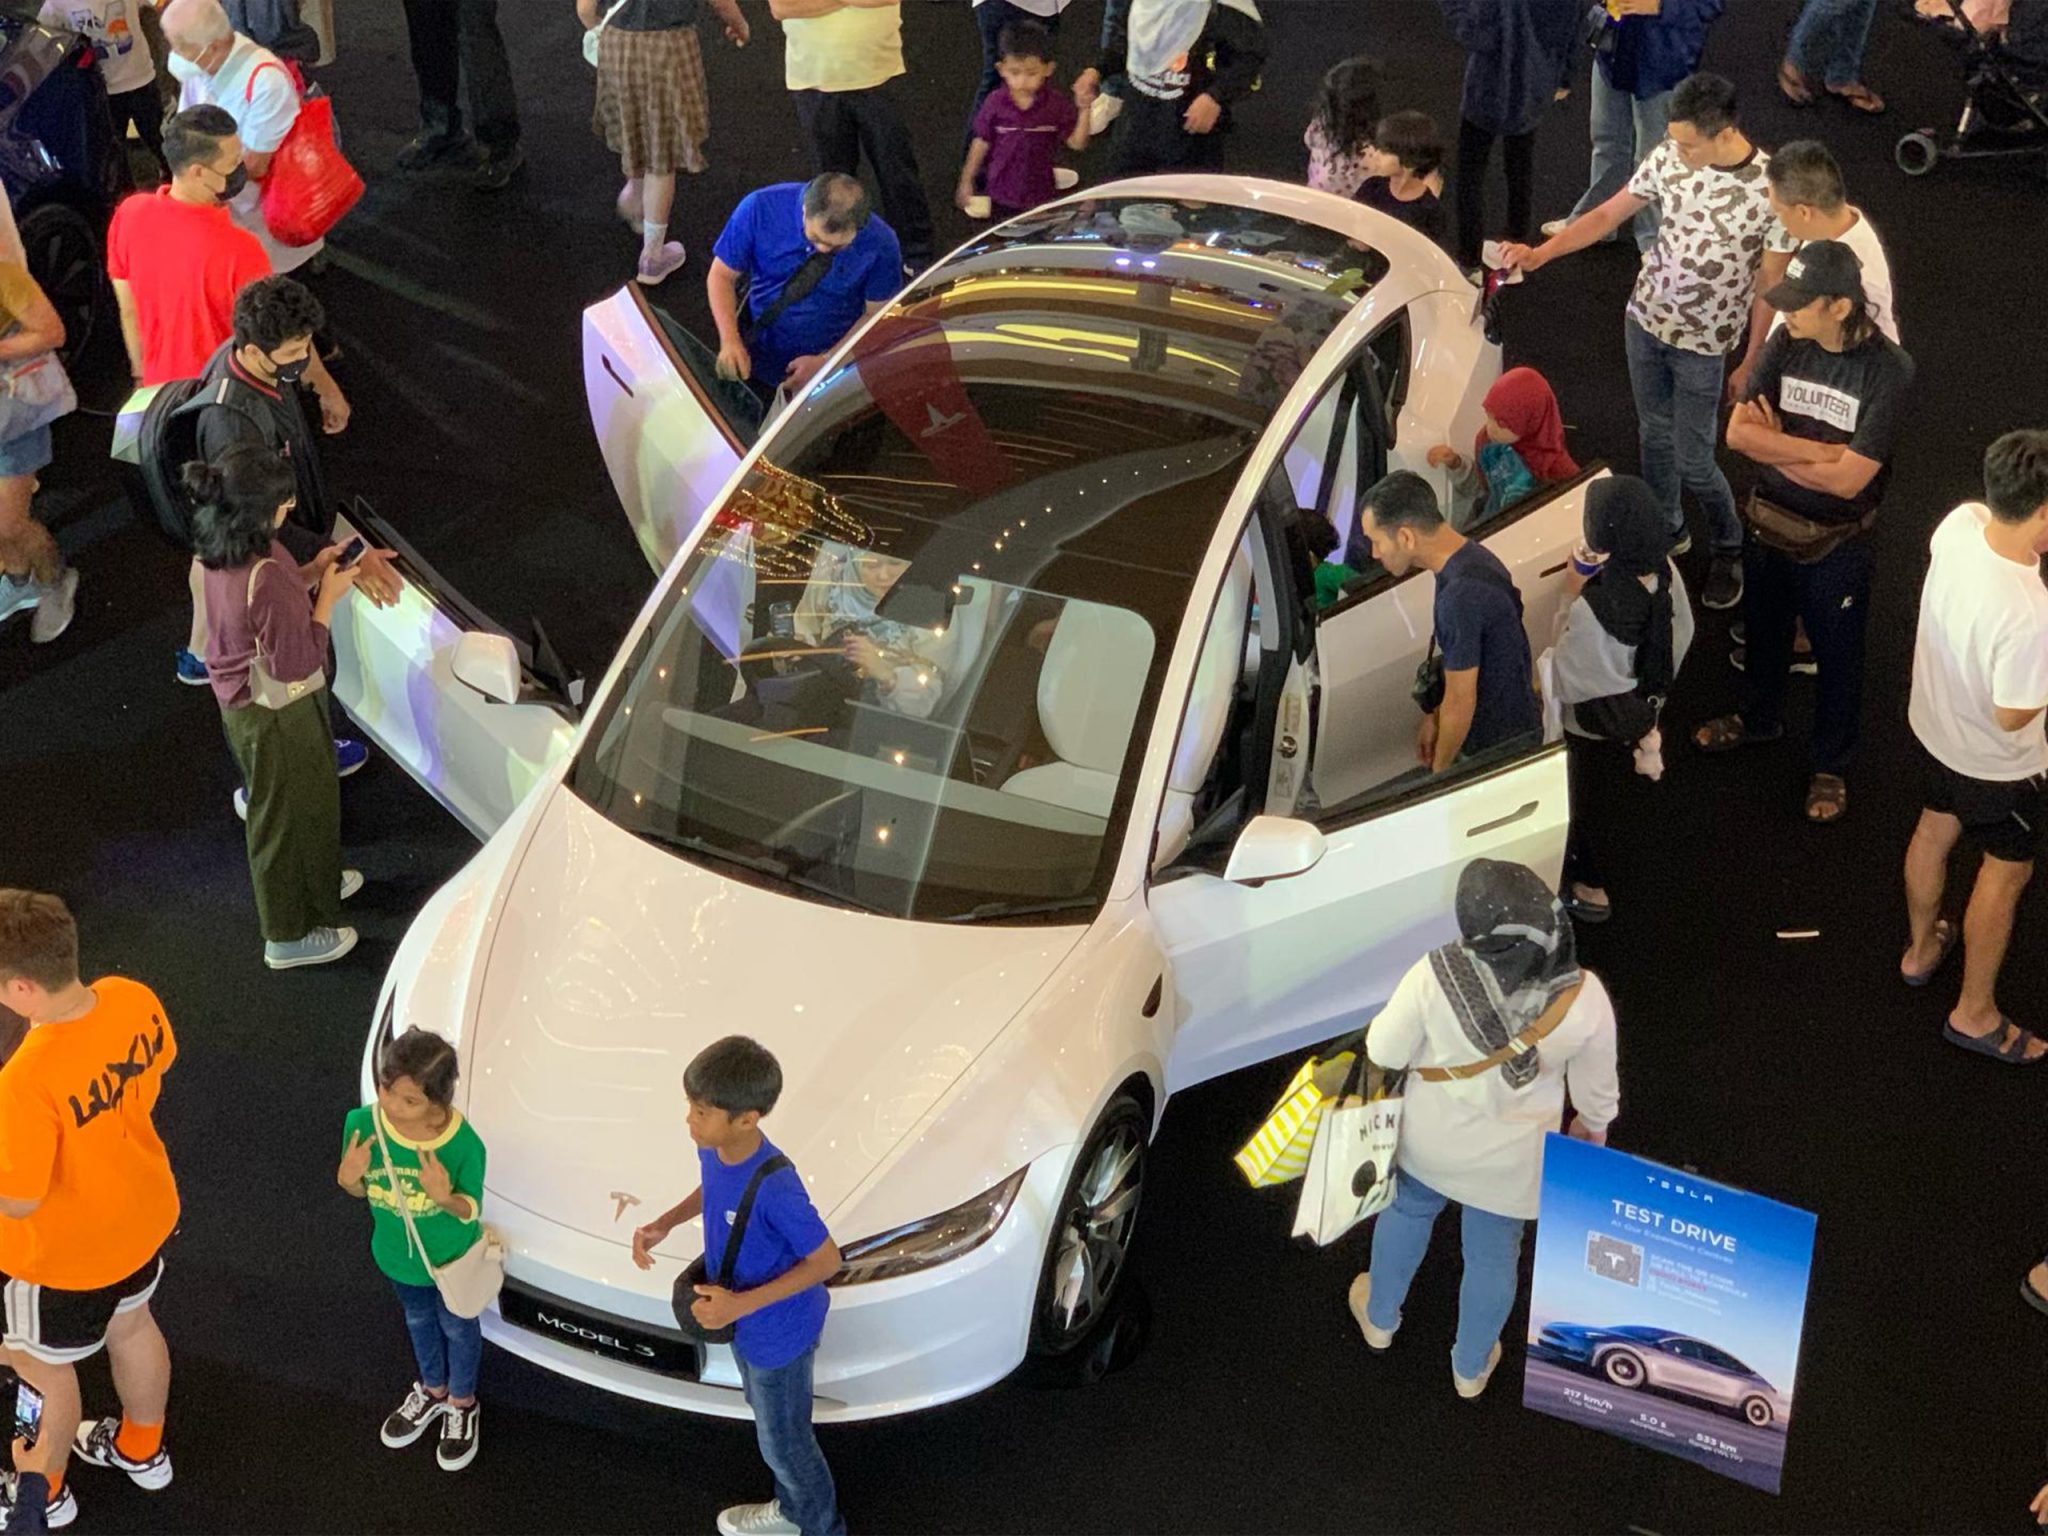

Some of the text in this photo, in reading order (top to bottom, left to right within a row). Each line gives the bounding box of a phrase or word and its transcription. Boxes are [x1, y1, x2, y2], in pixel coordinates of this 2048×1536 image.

[367, 1184, 437, 1212] adda
[1646, 1176, 1713, 1204] TESLA
[1612, 1199, 1737, 1252] TEST DRIVE
[538, 1312, 655, 1357] MODEL 3
[1563, 1387, 1613, 1410] 217 km/h
[1719, 1441, 1737, 1453] km
